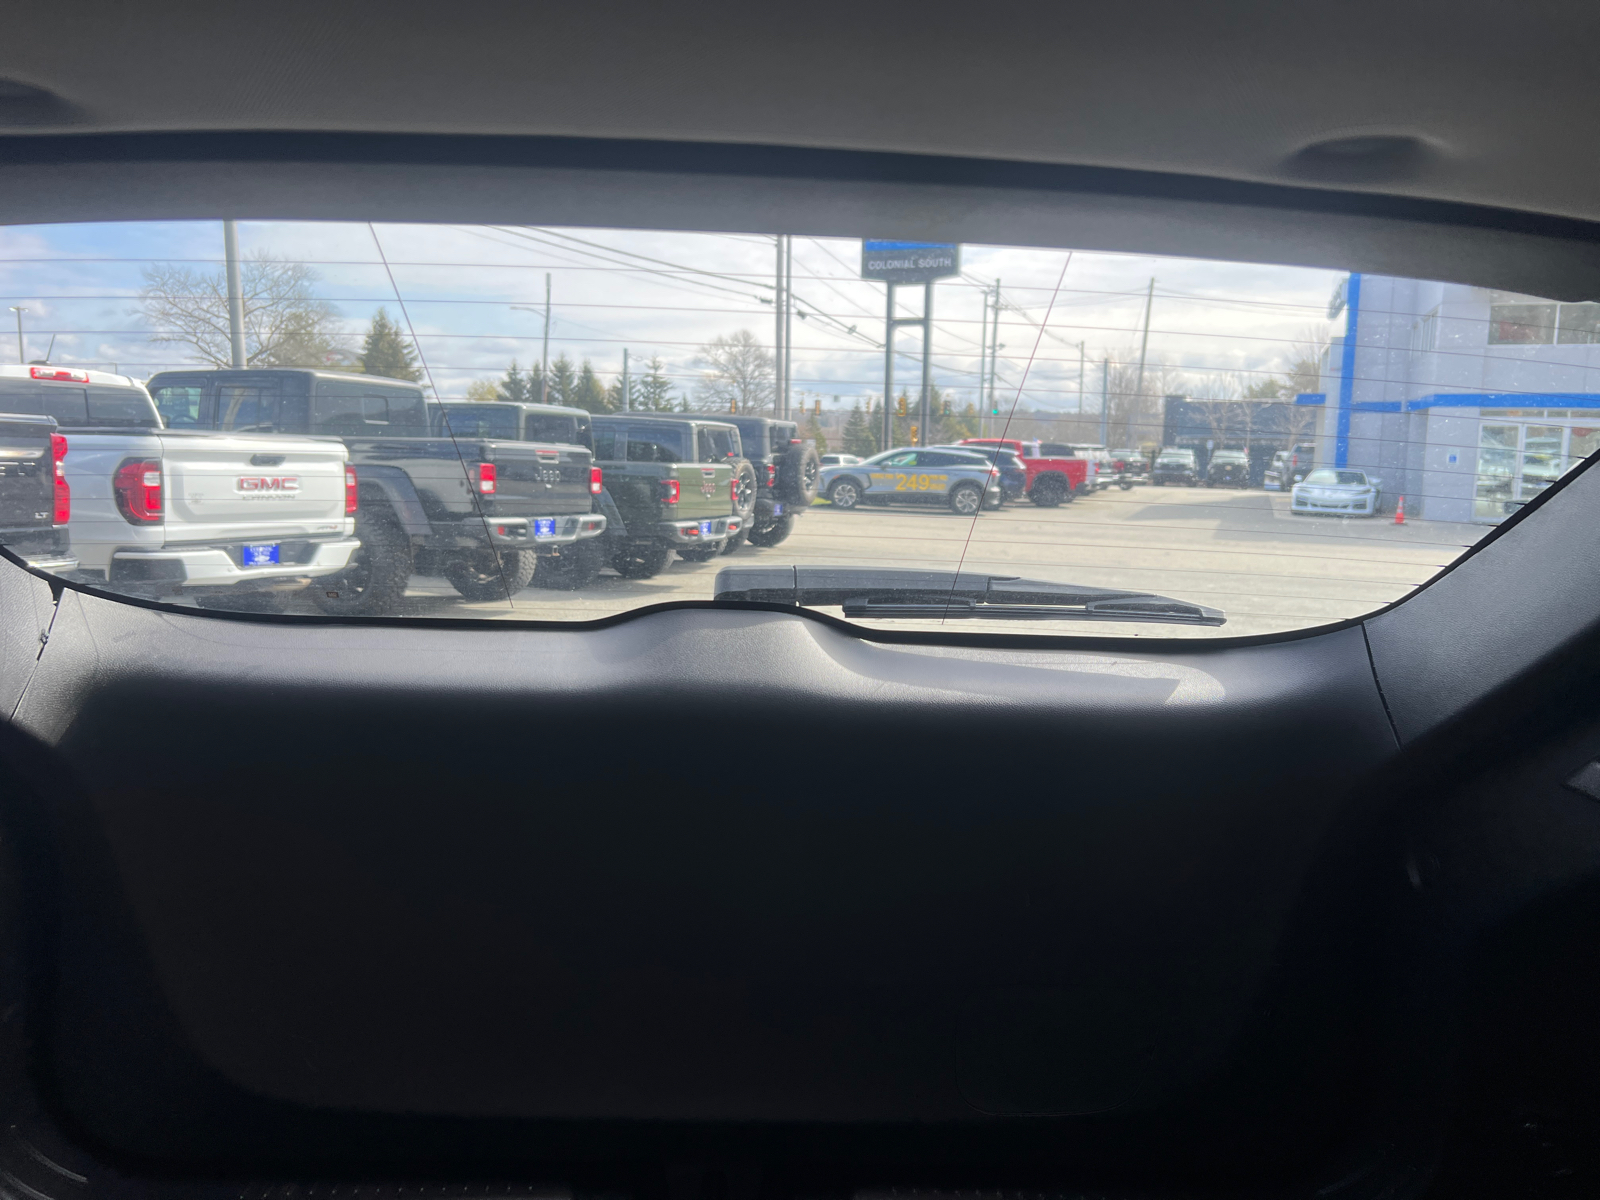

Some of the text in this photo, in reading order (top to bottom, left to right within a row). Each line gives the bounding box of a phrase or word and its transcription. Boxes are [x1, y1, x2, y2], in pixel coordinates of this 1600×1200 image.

[867, 257, 952, 270] COLONIAL SOUTH
[534, 467, 561, 481] Jeep
[239, 477, 299, 491] GMC
